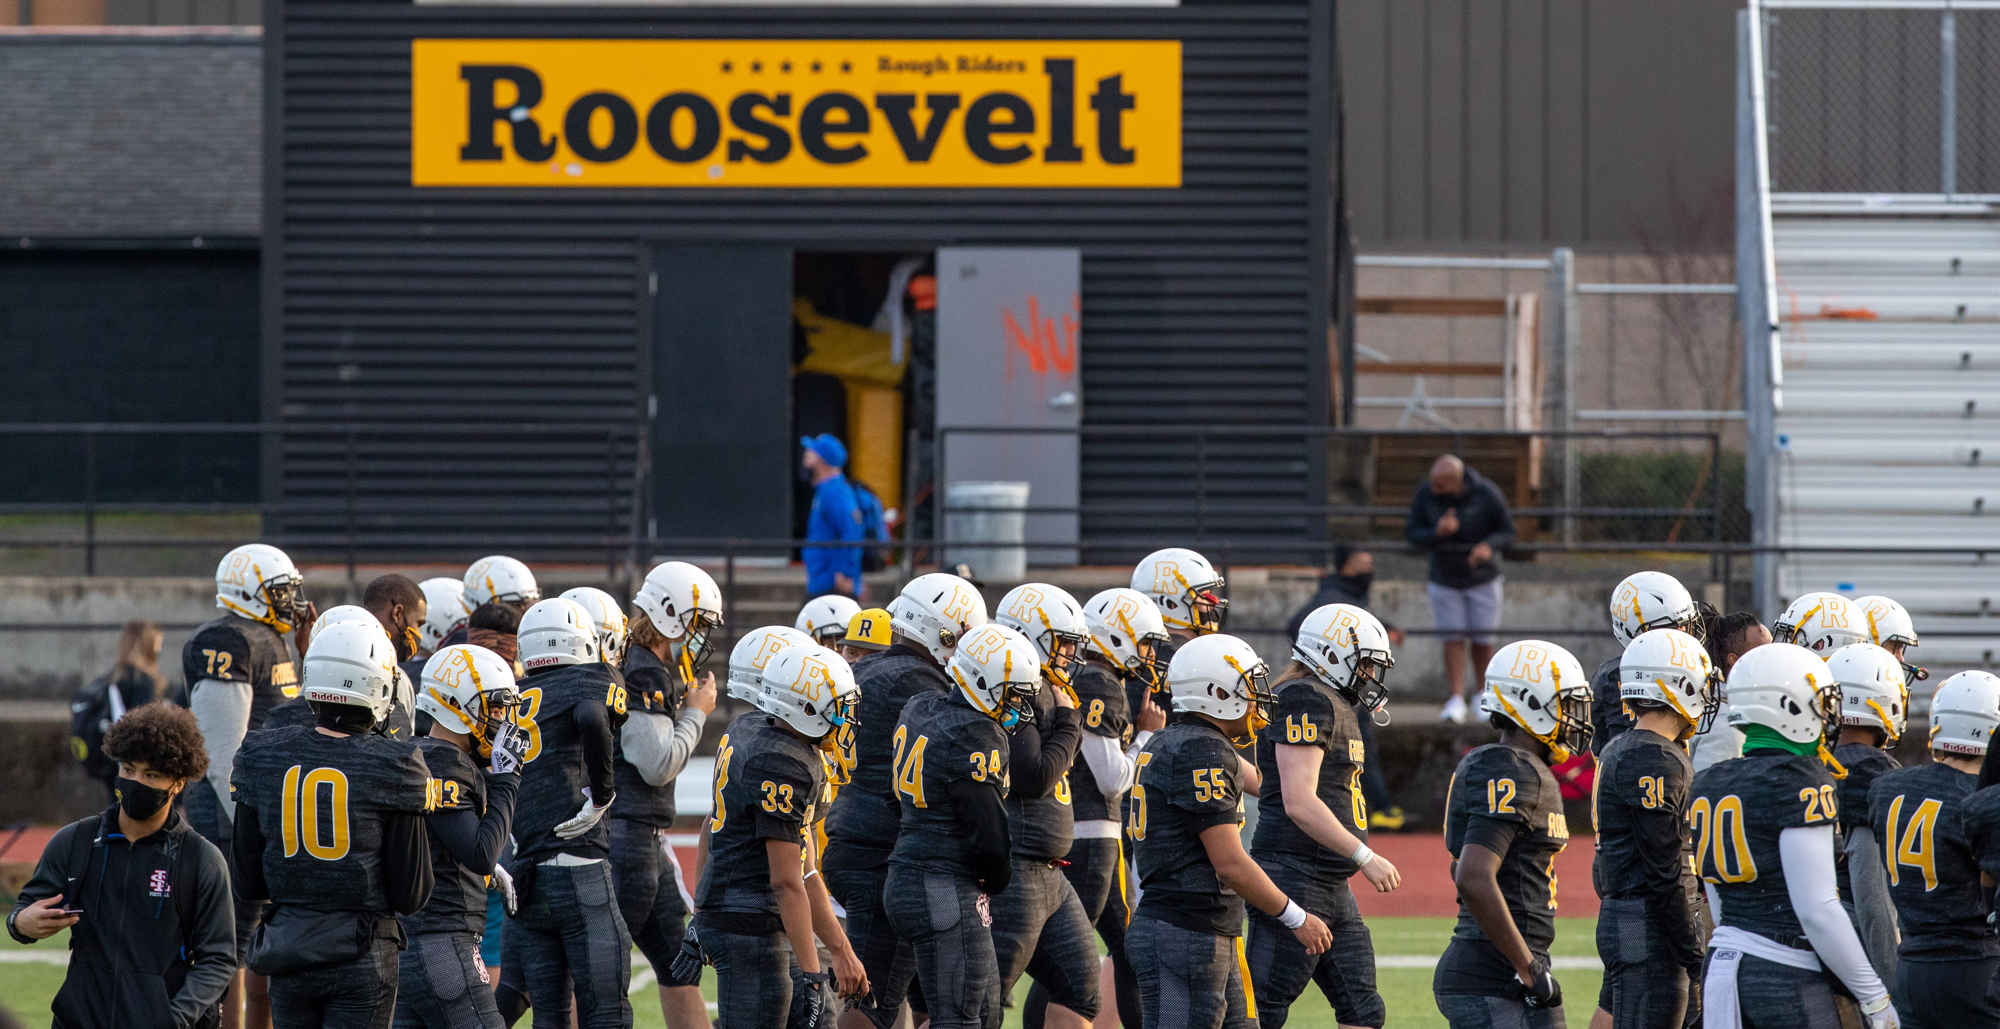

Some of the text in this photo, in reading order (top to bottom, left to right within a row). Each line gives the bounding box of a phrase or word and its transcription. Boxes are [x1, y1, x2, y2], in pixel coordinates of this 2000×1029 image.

[956, 54, 1026, 73] Riders
[458, 57, 1137, 165] Roosevelt
[223, 552, 250, 586] R
[1153, 561, 1179, 595] R
[943, 585, 976, 626] R
[1008, 587, 1044, 623] R
[1105, 595, 1139, 633] R
[1611, 581, 1638, 622] R
[1820, 598, 1848, 628] R
[548, 639, 556, 647] 18
[858, 619, 872, 637] R
[1323, 609, 1360, 648] R
[527, 657, 559, 668] Riddell
[966, 628, 1006, 665] R
[1510, 644, 1547, 683] R
[1666, 633, 1696, 670] R
[202, 649, 232, 680] 72
[433, 648, 473, 688] R
[791, 656, 829, 701] R
[1635, 671, 1643, 679] 31
[311, 692, 347, 703] Riddell
[343, 679, 353, 688] 10
[606, 682, 627, 714] 18
[765, 686, 771, 695] 33
[1087, 698, 1105, 728] 8
[1286, 713, 1317, 743] 66
[1943, 742, 1981, 754] Riddell
[970, 749, 1001, 782] 34
[761, 780, 793, 814] 33
[1192, 768, 1226, 802] 55
[1487, 778, 1516, 814] 12
[1639, 775, 1664, 809] 31
[281, 764, 351, 861] 10
[1800, 784, 1837, 823] 20
[1690, 794, 1758, 884] 20
[1886, 794, 1944, 893] 14
